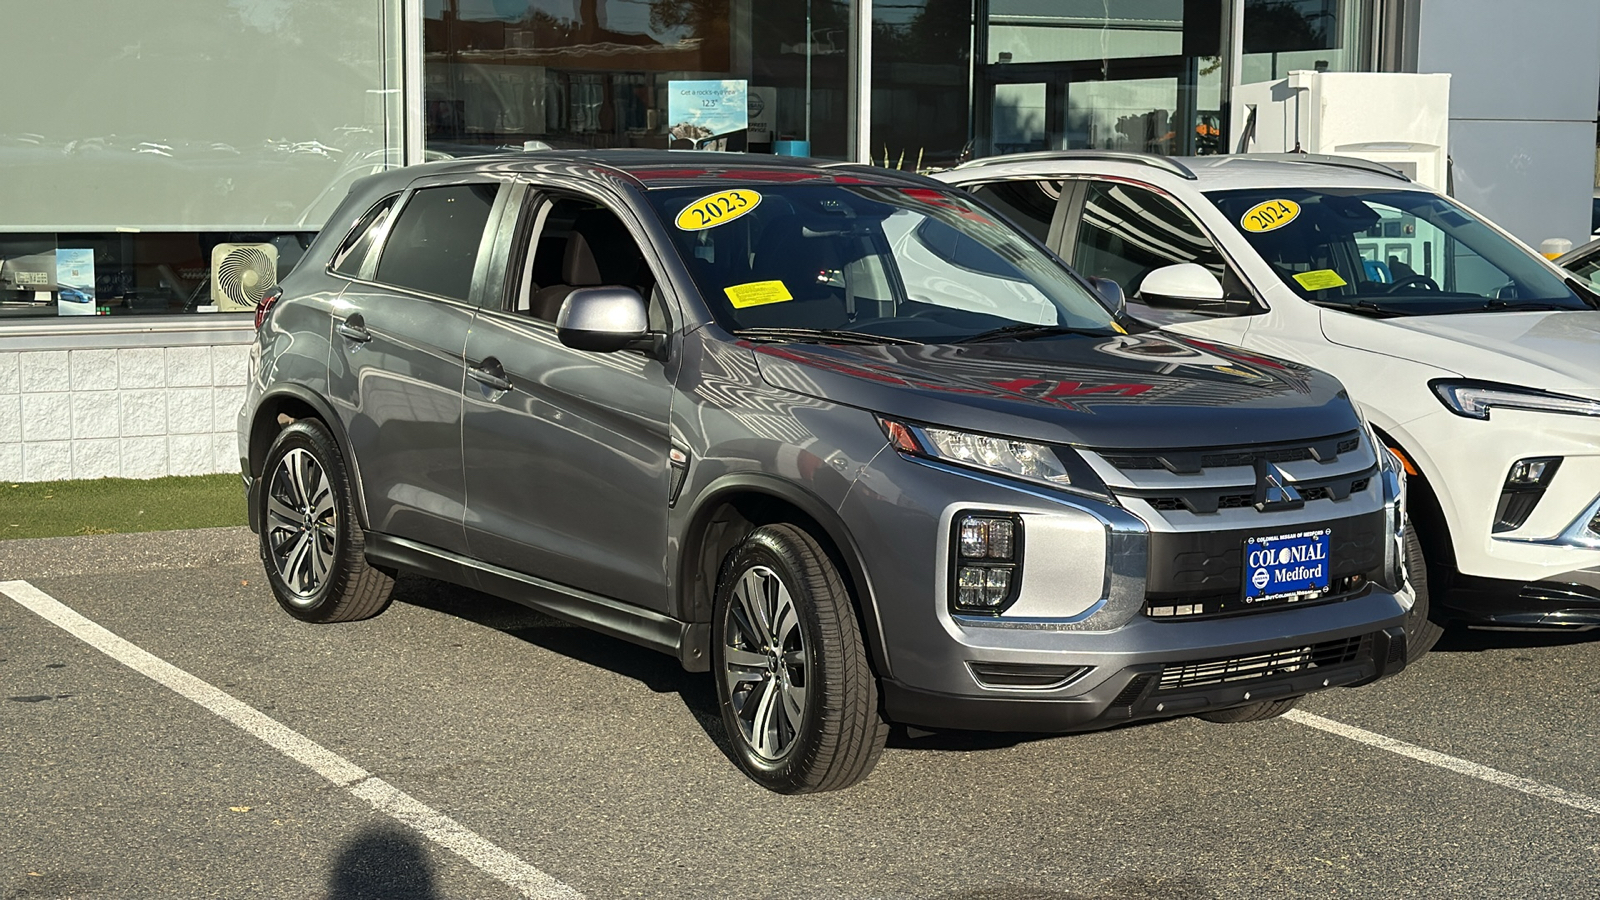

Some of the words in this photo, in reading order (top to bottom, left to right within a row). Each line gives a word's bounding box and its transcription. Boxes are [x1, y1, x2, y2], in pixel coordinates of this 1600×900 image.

[692, 192, 748, 226] 2023
[1251, 201, 1291, 229] 2024
[1256, 535, 1280, 543] COLONIAL
[1279, 532, 1297, 540] NISSAN
[1303, 530, 1324, 538] MEDFORD
[1249, 543, 1326, 568] COLONIAL
[1274, 564, 1322, 583] Medford
